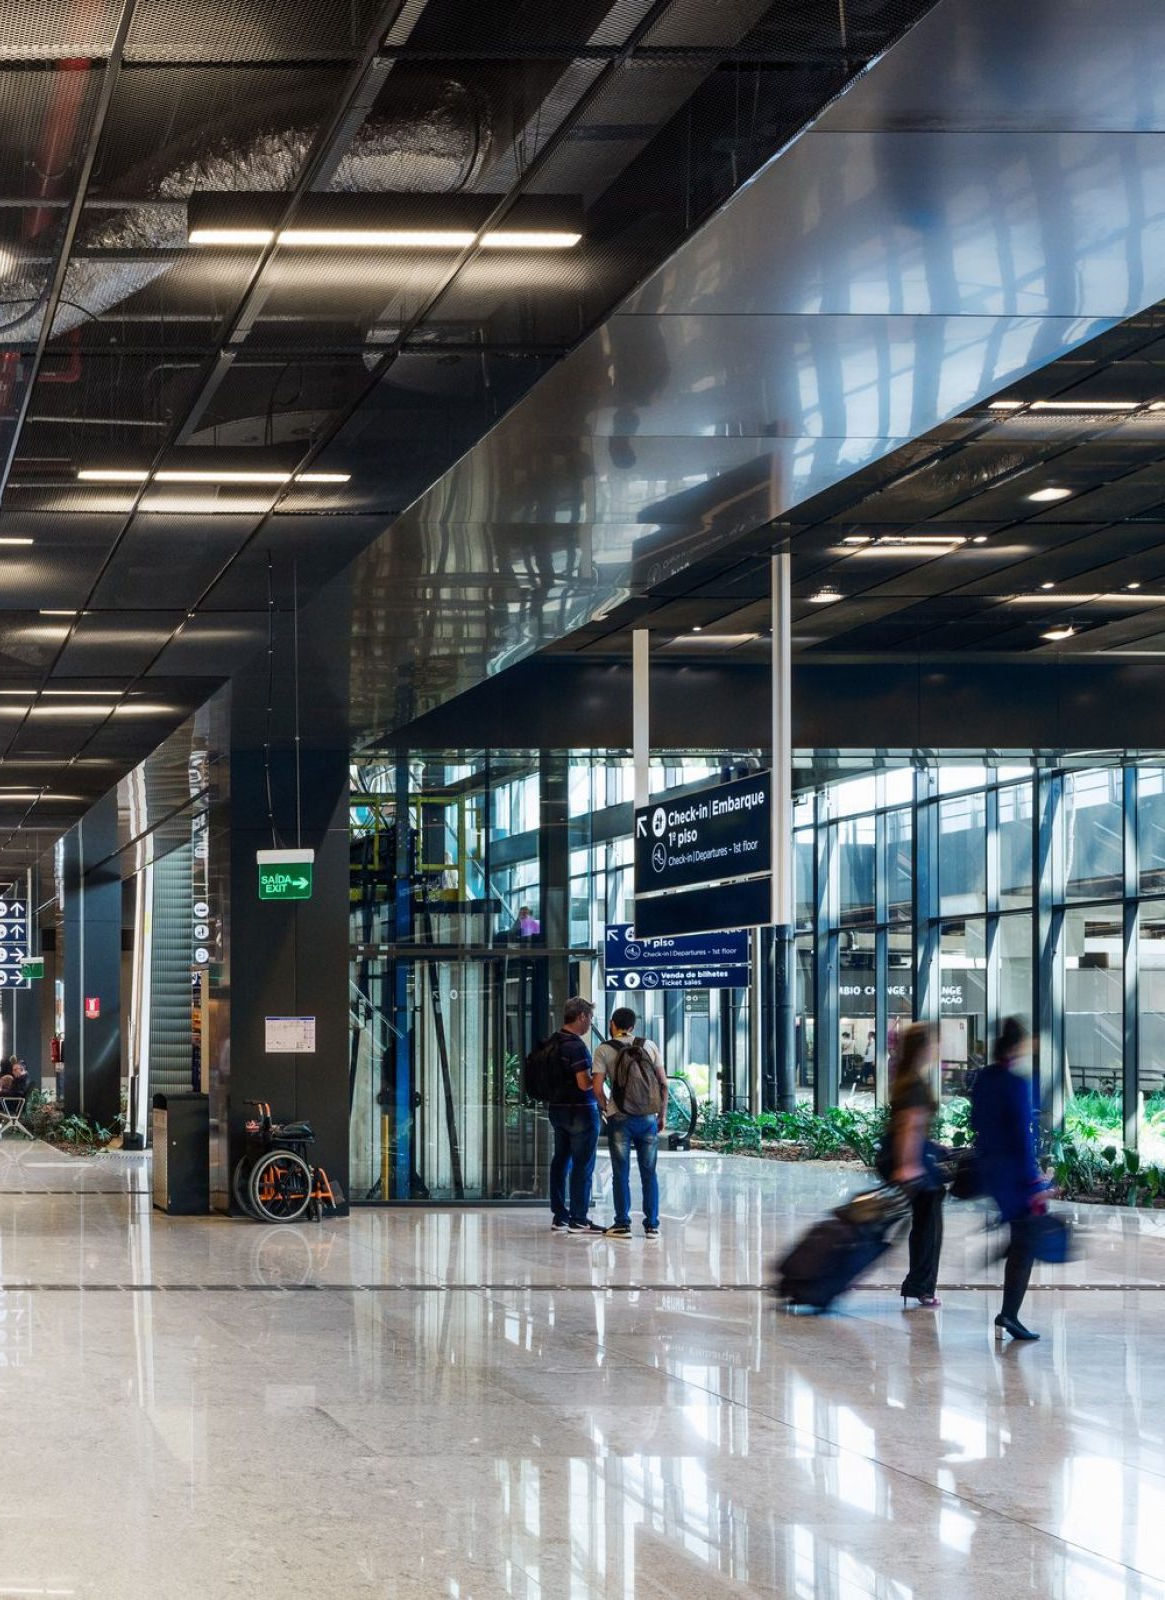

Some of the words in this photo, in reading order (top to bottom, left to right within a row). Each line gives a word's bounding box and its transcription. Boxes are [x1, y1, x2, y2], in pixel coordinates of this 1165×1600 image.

[668, 803, 708, 827] Check-in
[712, 791, 765, 816] Embarque
[677, 828, 698, 848] piso
[668, 853, 693, 866] Check-in
[696, 847, 728, 862] Departures
[733, 842, 742, 853] 1st
[742, 840, 758, 851] floor
[261, 873, 292, 885] SAÍDA
[265, 884, 288, 893] EXIT
[653, 938, 675, 949] piso
[697, 970, 728, 978] bilhetes
